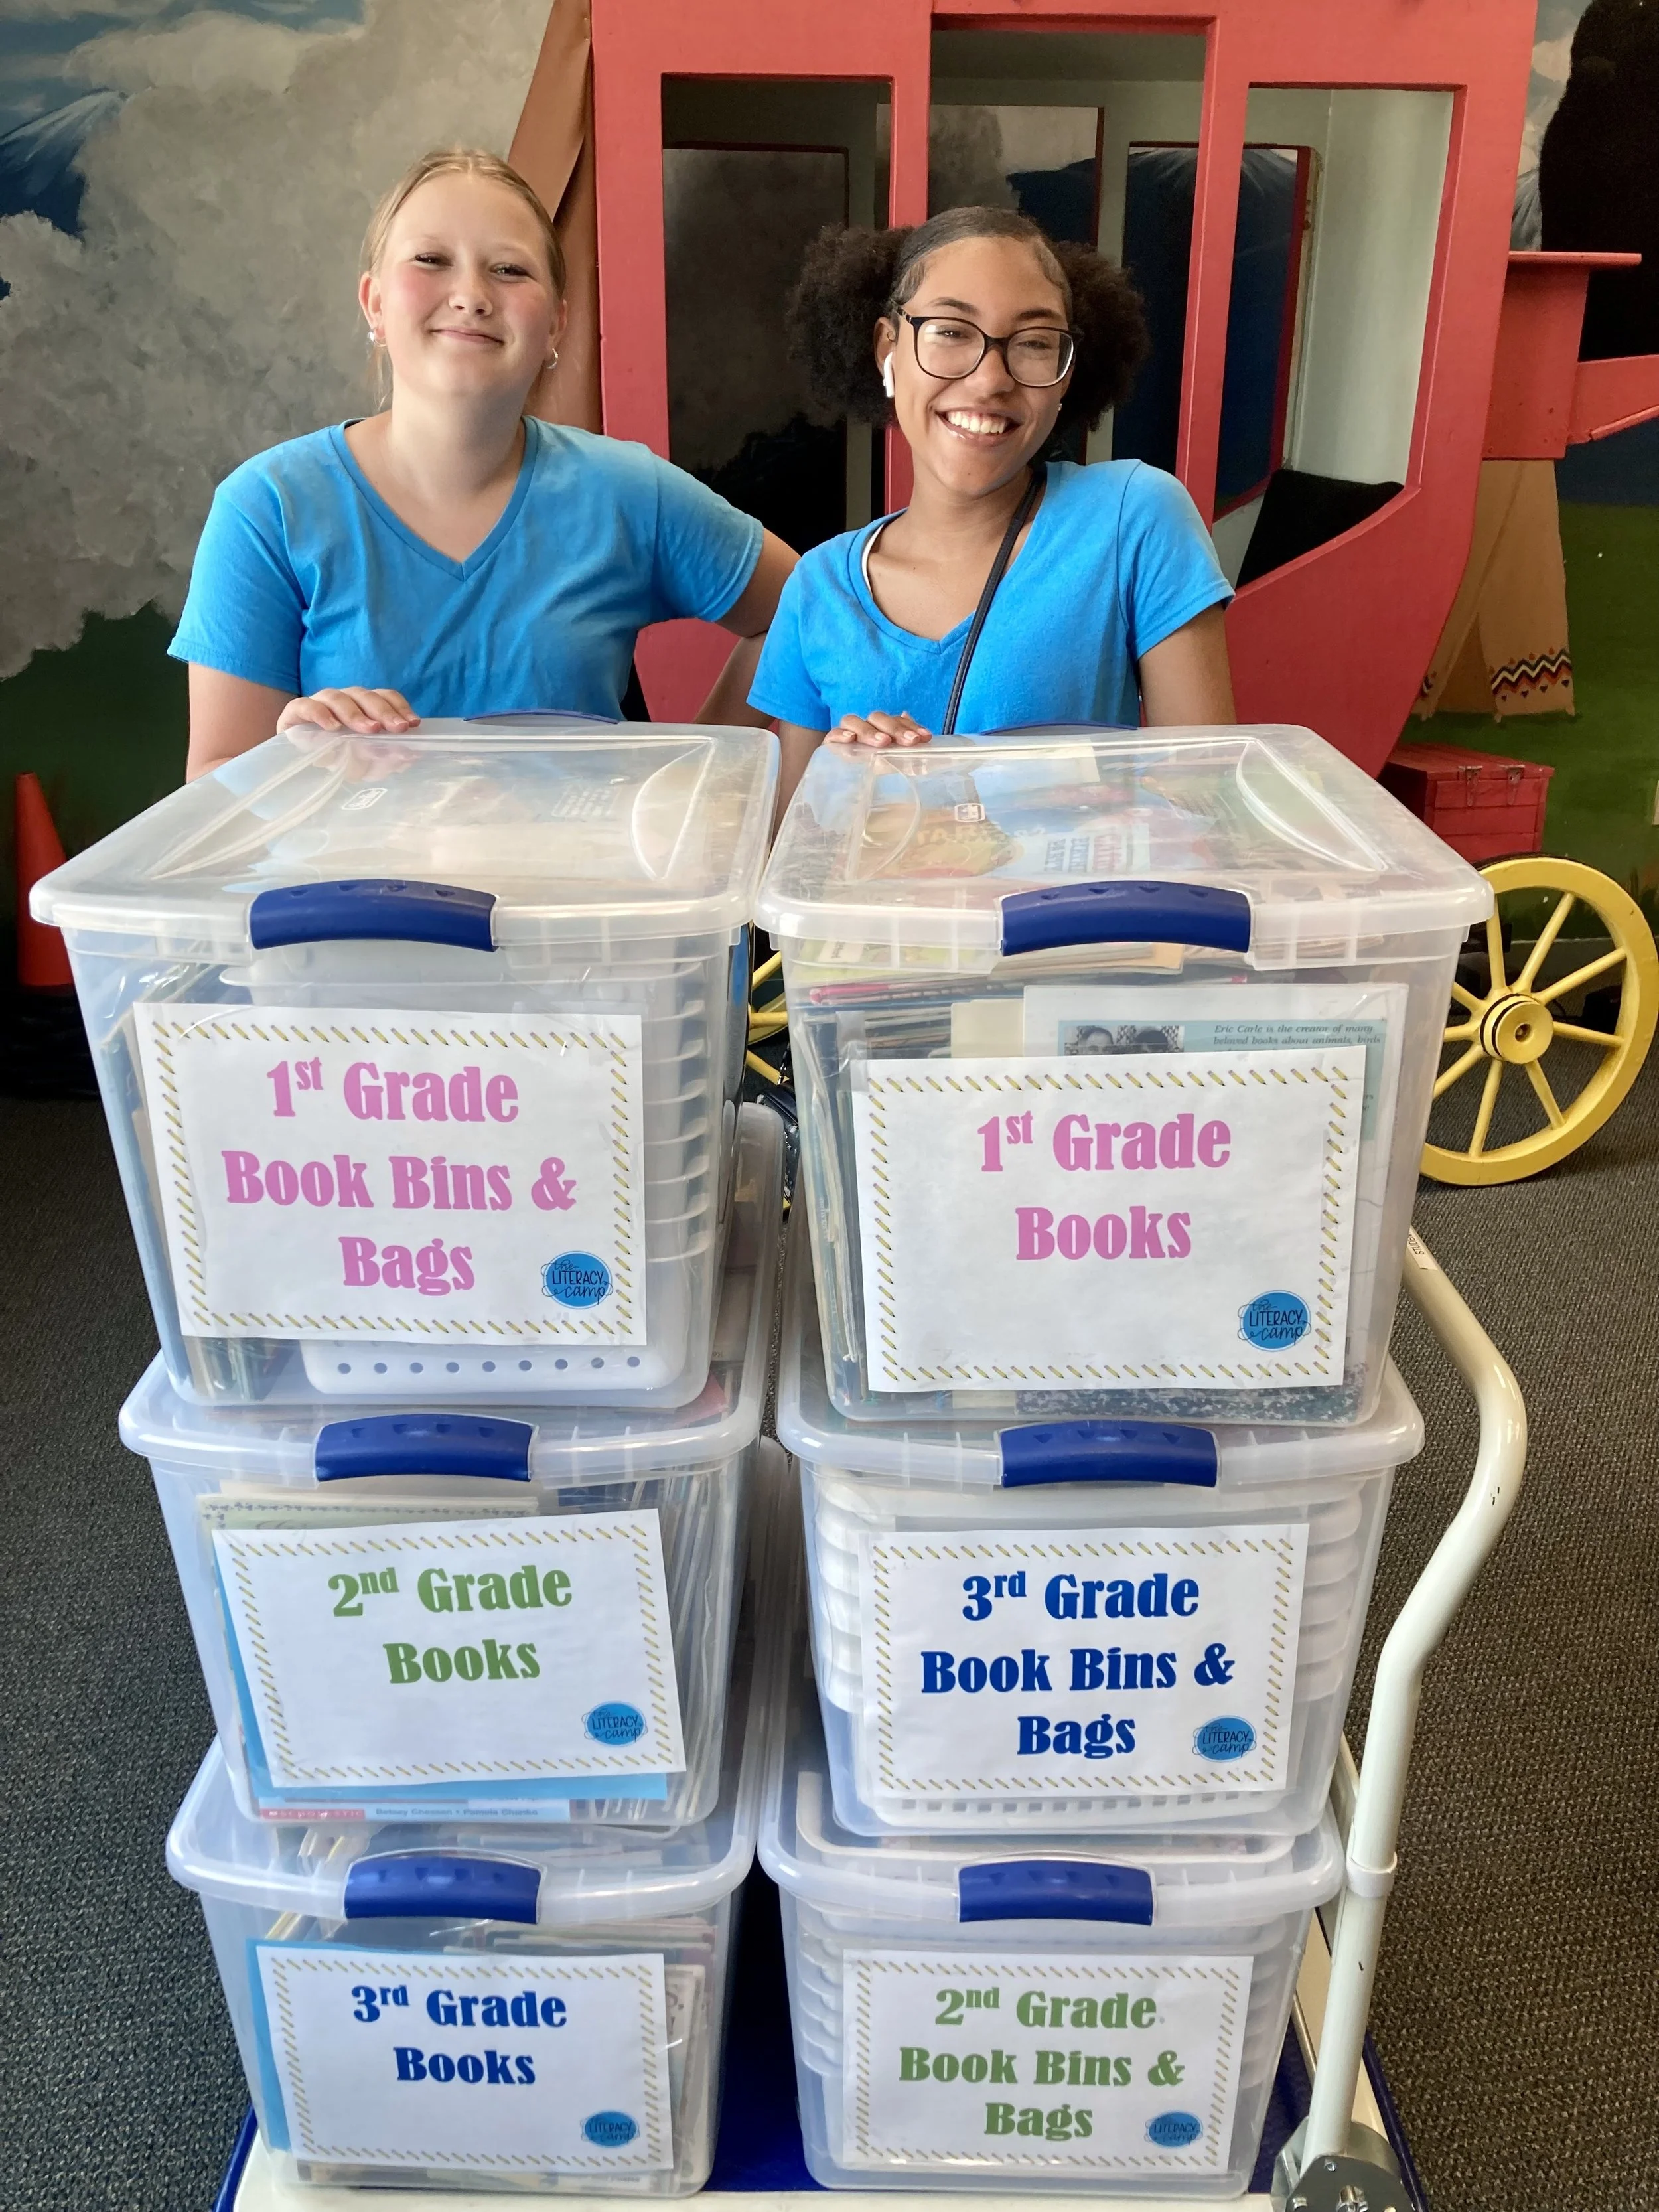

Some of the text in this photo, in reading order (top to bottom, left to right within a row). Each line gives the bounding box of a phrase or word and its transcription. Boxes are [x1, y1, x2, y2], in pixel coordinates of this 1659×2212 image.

[1213, 1036, 1248, 1045] beloved
[1251, 1036, 1279, 1045] books
[1281, 1035, 1309, 1044] about
[1356, 1035, 1382, 1044] birds
[1214, 1025, 1234, 1033] Eric
[1237, 1025, 1263, 1033] Carle
[1277, 1024, 1293, 1033] the
[1331, 1023, 1344, 1034] of
[1345, 1025, 1374, 1035] many
[268, 1058, 518, 1122] 1st Grade
[977, 1111, 1230, 1173] 1st Grade
[222, 1151, 577, 1211] Book Bins &
[1016, 1205, 1191, 1260] Books
[1407, 1234, 1425, 1255] STUDE
[340, 1236, 474, 1296] Bags
[551, 1270, 605, 1285] LITERACY
[553, 1259, 579, 1270] the
[556, 1286, 607, 1305] camp
[1251, 1299, 1278, 1311] the
[1249, 1309, 1303, 1327] LITERACY
[1253, 1326, 1305, 1346] camp
[328, 1565, 571, 1617] 2nd Grade
[963, 1572, 1198, 1621] 3rd Grade
[383, 1639, 540, 1684] Books
[921, 1643, 1234, 1694] Book Bins &
[591, 1714, 639, 1730] LITERACY
[599, 1728, 641, 1743] camp
[1019, 1714, 1135, 1759] Bags
[1202, 1730, 1250, 1745] LITERACY
[1206, 1743, 1250, 1758] camp
[352, 1986, 565, 2027] 3rd Grade
[936, 1988, 1156, 2029] 2nd Grade
[395, 2047, 536, 2084] Books
[901, 2047, 1182, 2087] Book Bins &
[986, 2103, 1093, 2141] Bags
